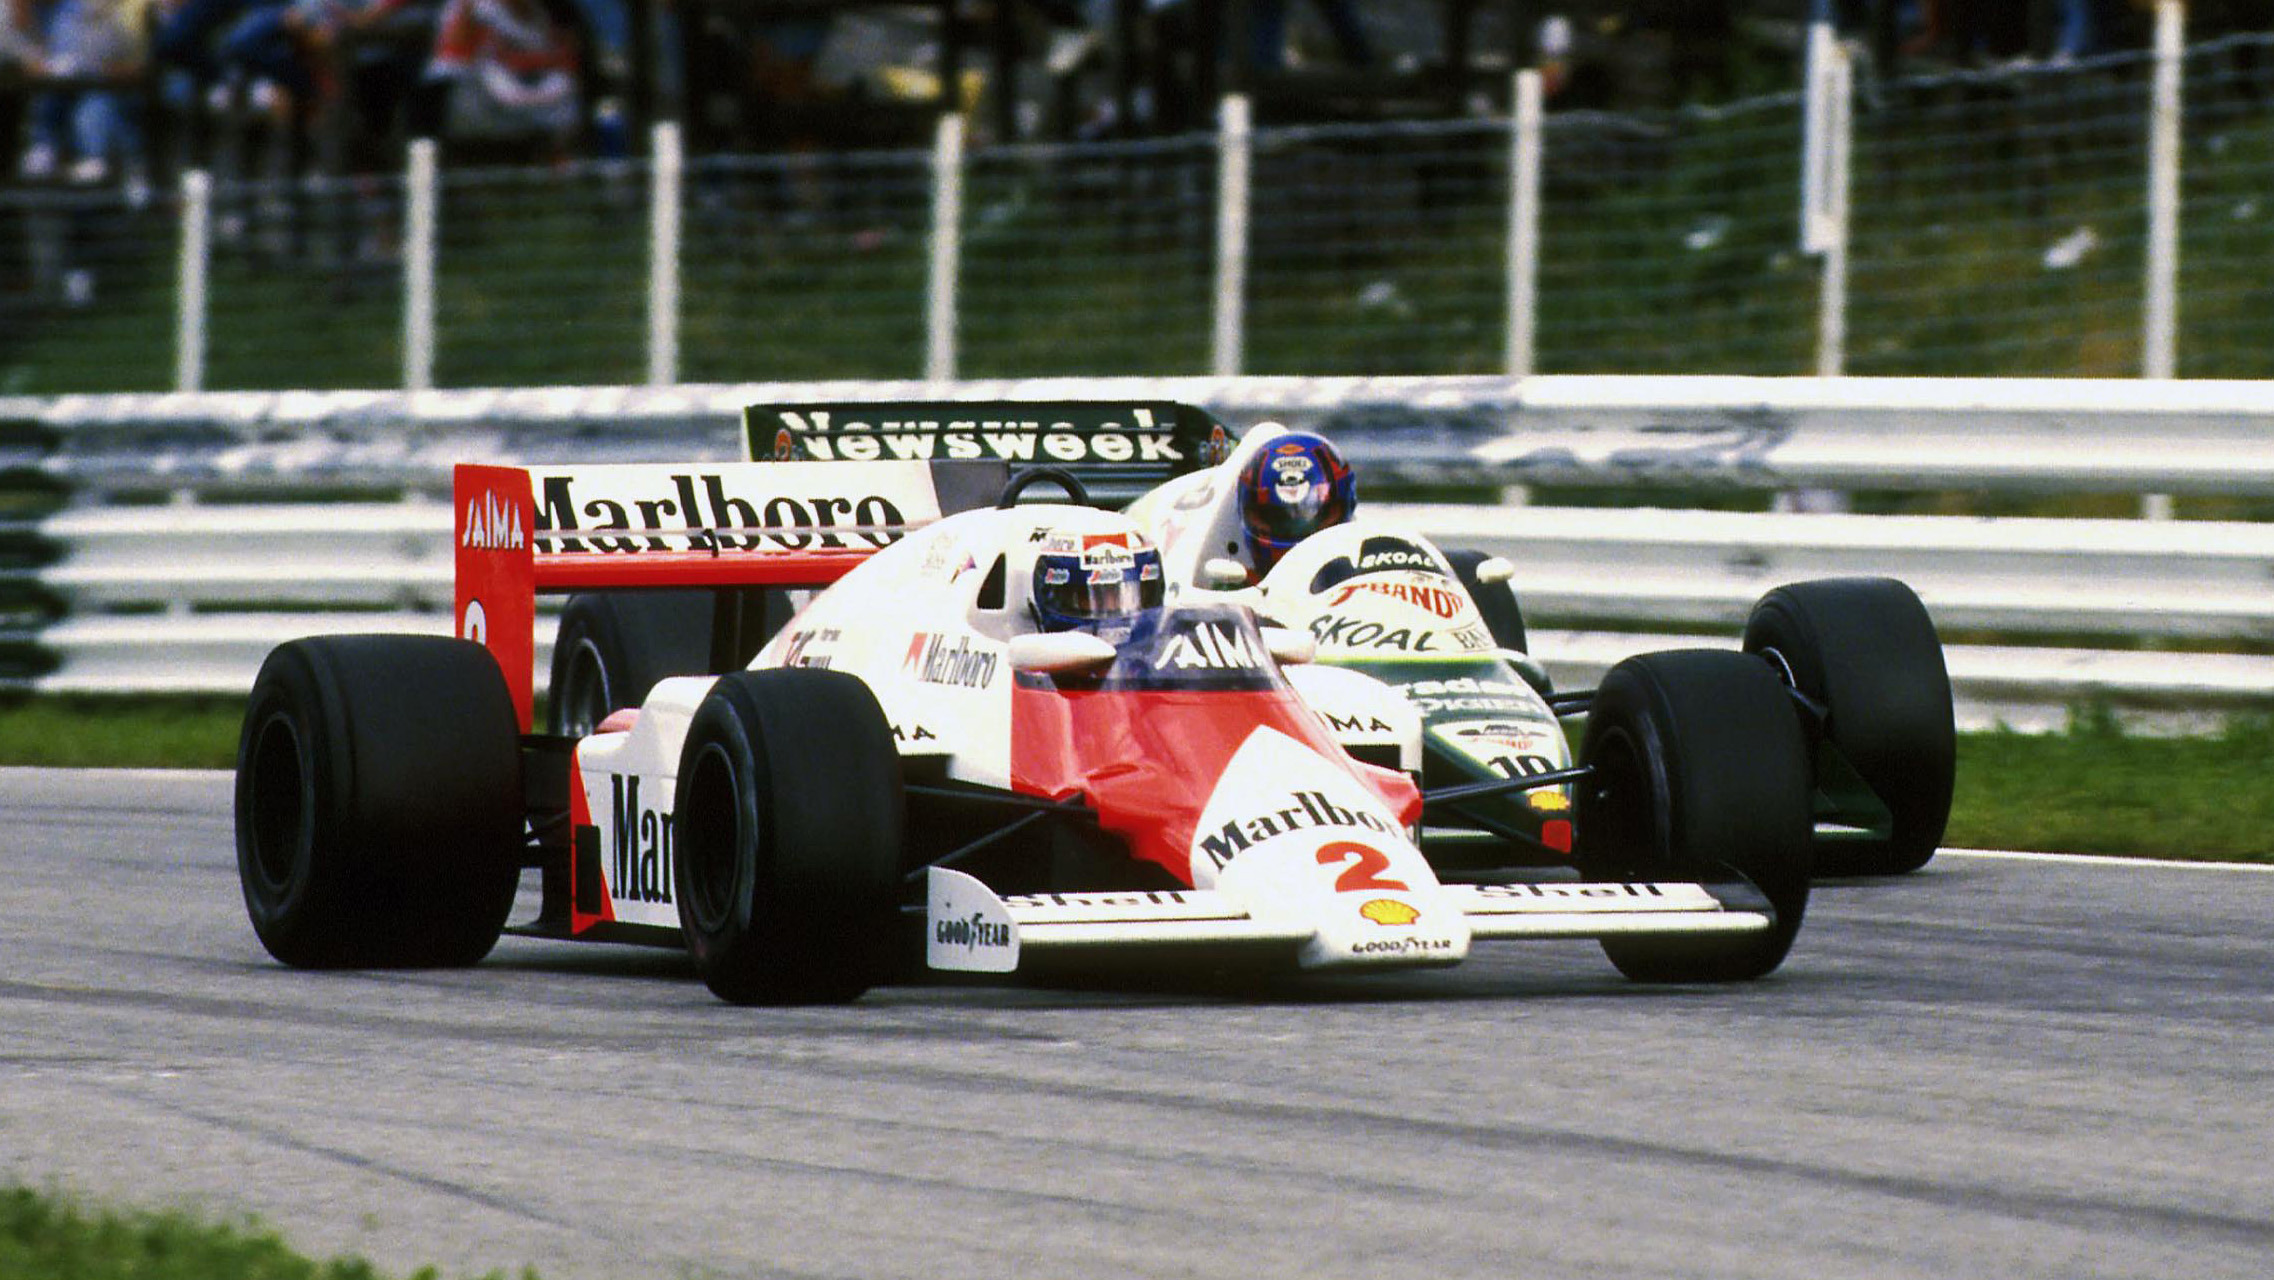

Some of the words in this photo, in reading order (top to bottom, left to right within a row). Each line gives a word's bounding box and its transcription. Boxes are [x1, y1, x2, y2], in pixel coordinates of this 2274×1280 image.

[779, 409, 1184, 461] Newsweek
[534, 474, 906, 554] Marlboro
[1361, 551, 1437, 568] SKOAL
[1309, 614, 1439, 652] SKOAL
[1315, 840, 1411, 894] 2
